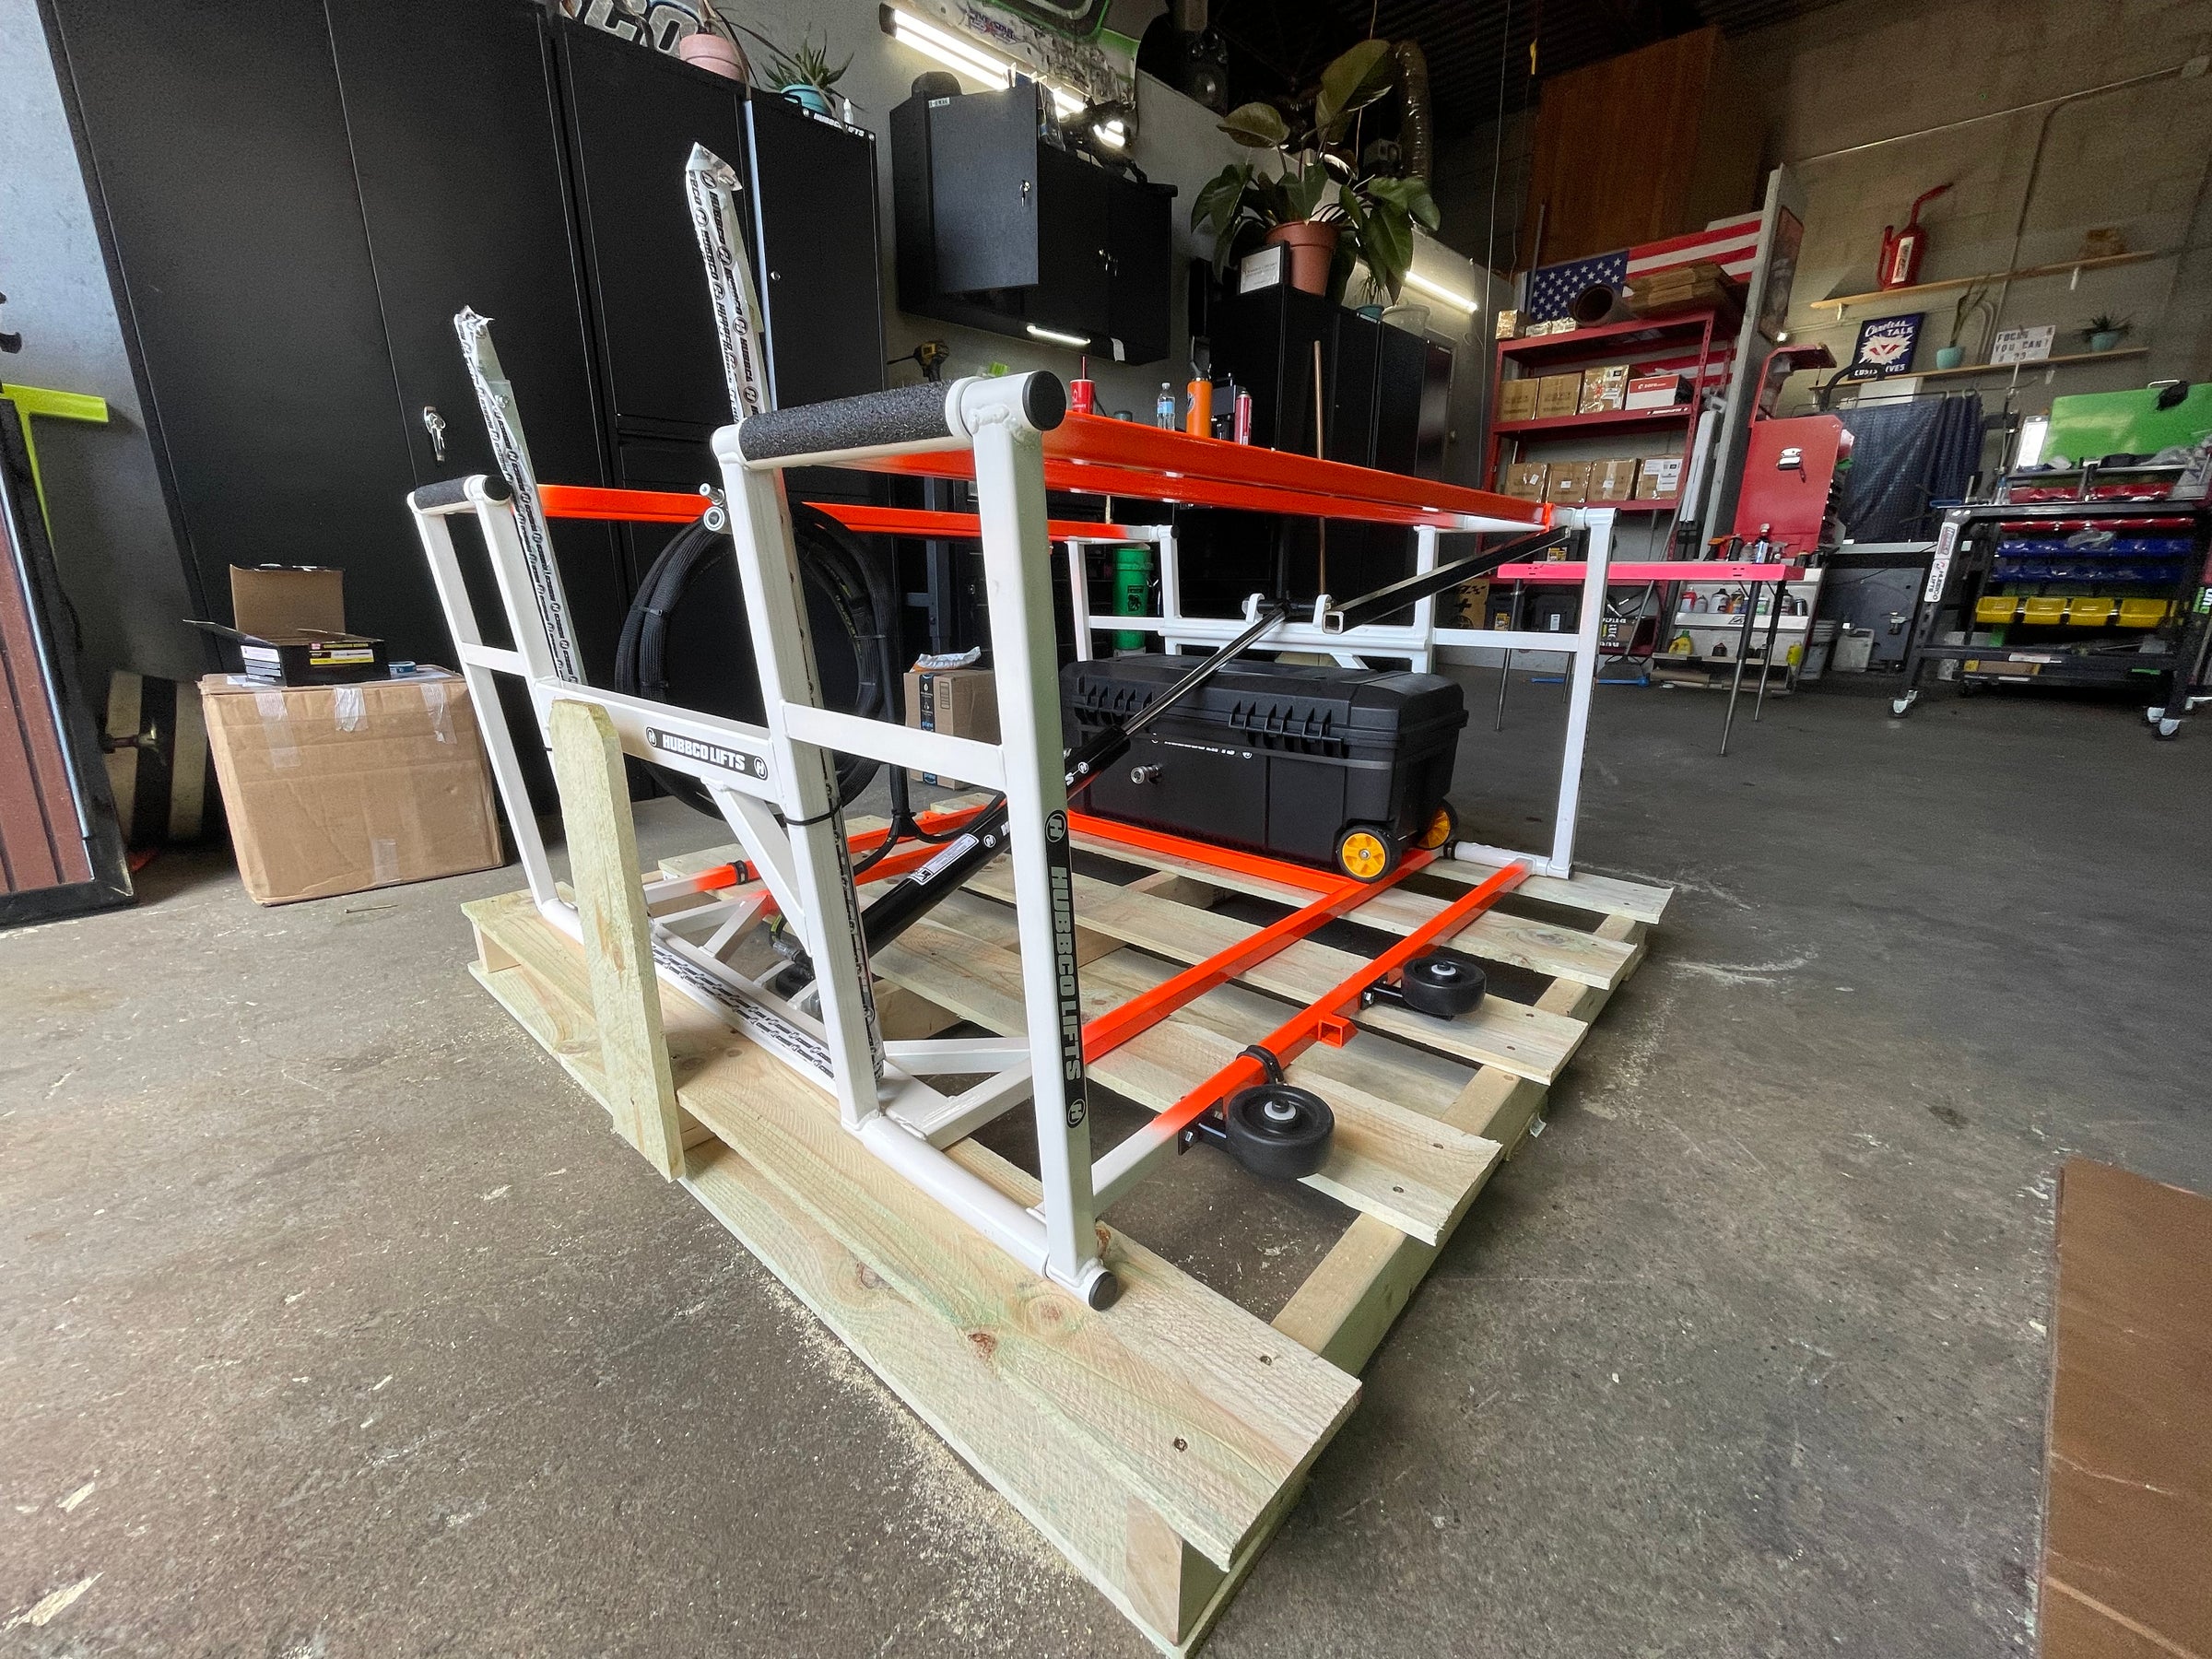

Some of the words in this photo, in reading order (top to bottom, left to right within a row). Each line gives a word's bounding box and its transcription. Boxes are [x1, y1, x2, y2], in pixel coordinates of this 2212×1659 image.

[709, 191, 726, 245] HUBBCO
[1887, 326, 1914, 336] TALK
[1995, 344, 2015, 352] YOU
[662, 734, 709, 760] HUBBCO
[709, 747, 746, 771] LIFTS
[1051, 865, 1076, 996] HUBBCO
[1061, 1000, 1082, 1081] LIFTS
